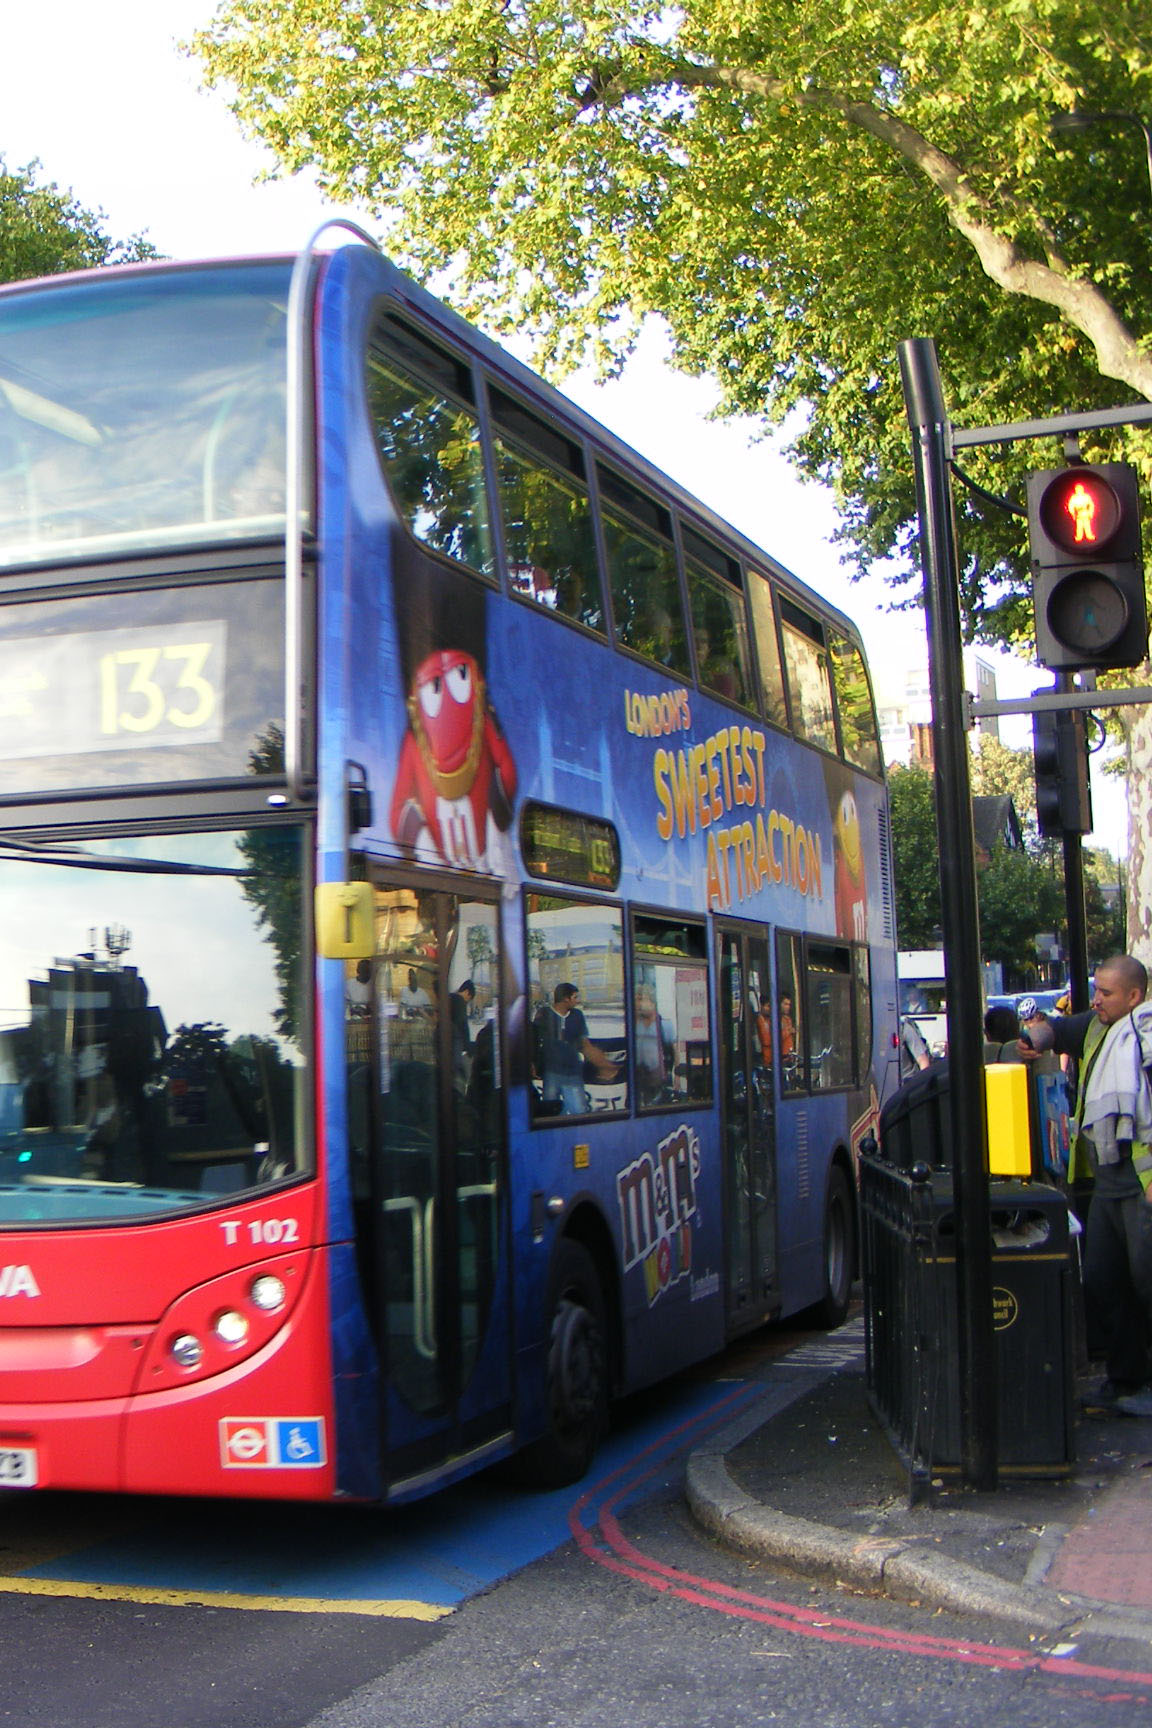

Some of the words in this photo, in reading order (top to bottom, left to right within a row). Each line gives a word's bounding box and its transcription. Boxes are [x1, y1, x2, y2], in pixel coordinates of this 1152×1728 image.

[101, 643, 216, 735] 133
[624, 688, 691, 738] LONDON'S
[654, 725, 766, 840] SWEETEST
[706, 809, 824, 910] ATTRACTION
[220, 1219, 242, 1245] T
[248, 1217, 300, 1244] 102
